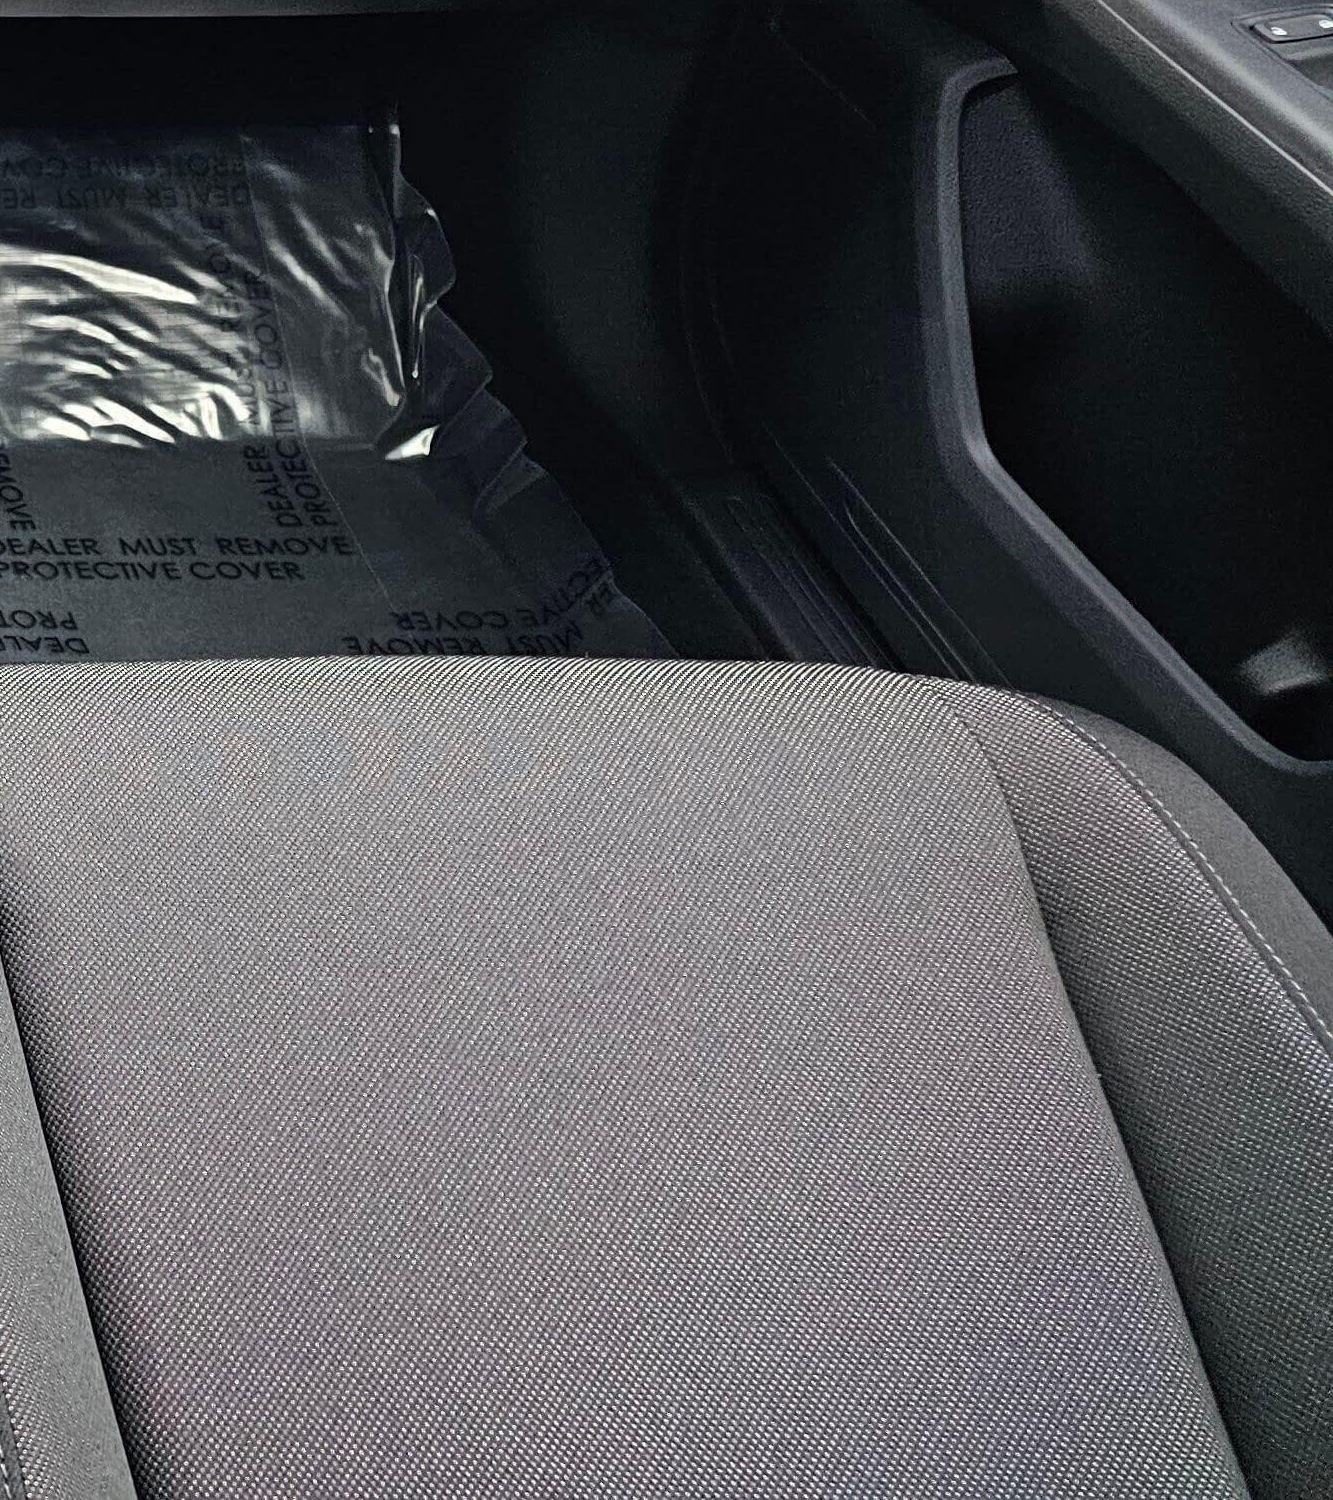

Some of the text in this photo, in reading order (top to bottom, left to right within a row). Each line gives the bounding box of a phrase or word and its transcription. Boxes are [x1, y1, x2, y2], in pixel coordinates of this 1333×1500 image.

[119, 537, 195, 557] MUST
[217, 536, 355, 557] REMOVE
[187, 561, 303, 580] COVER
